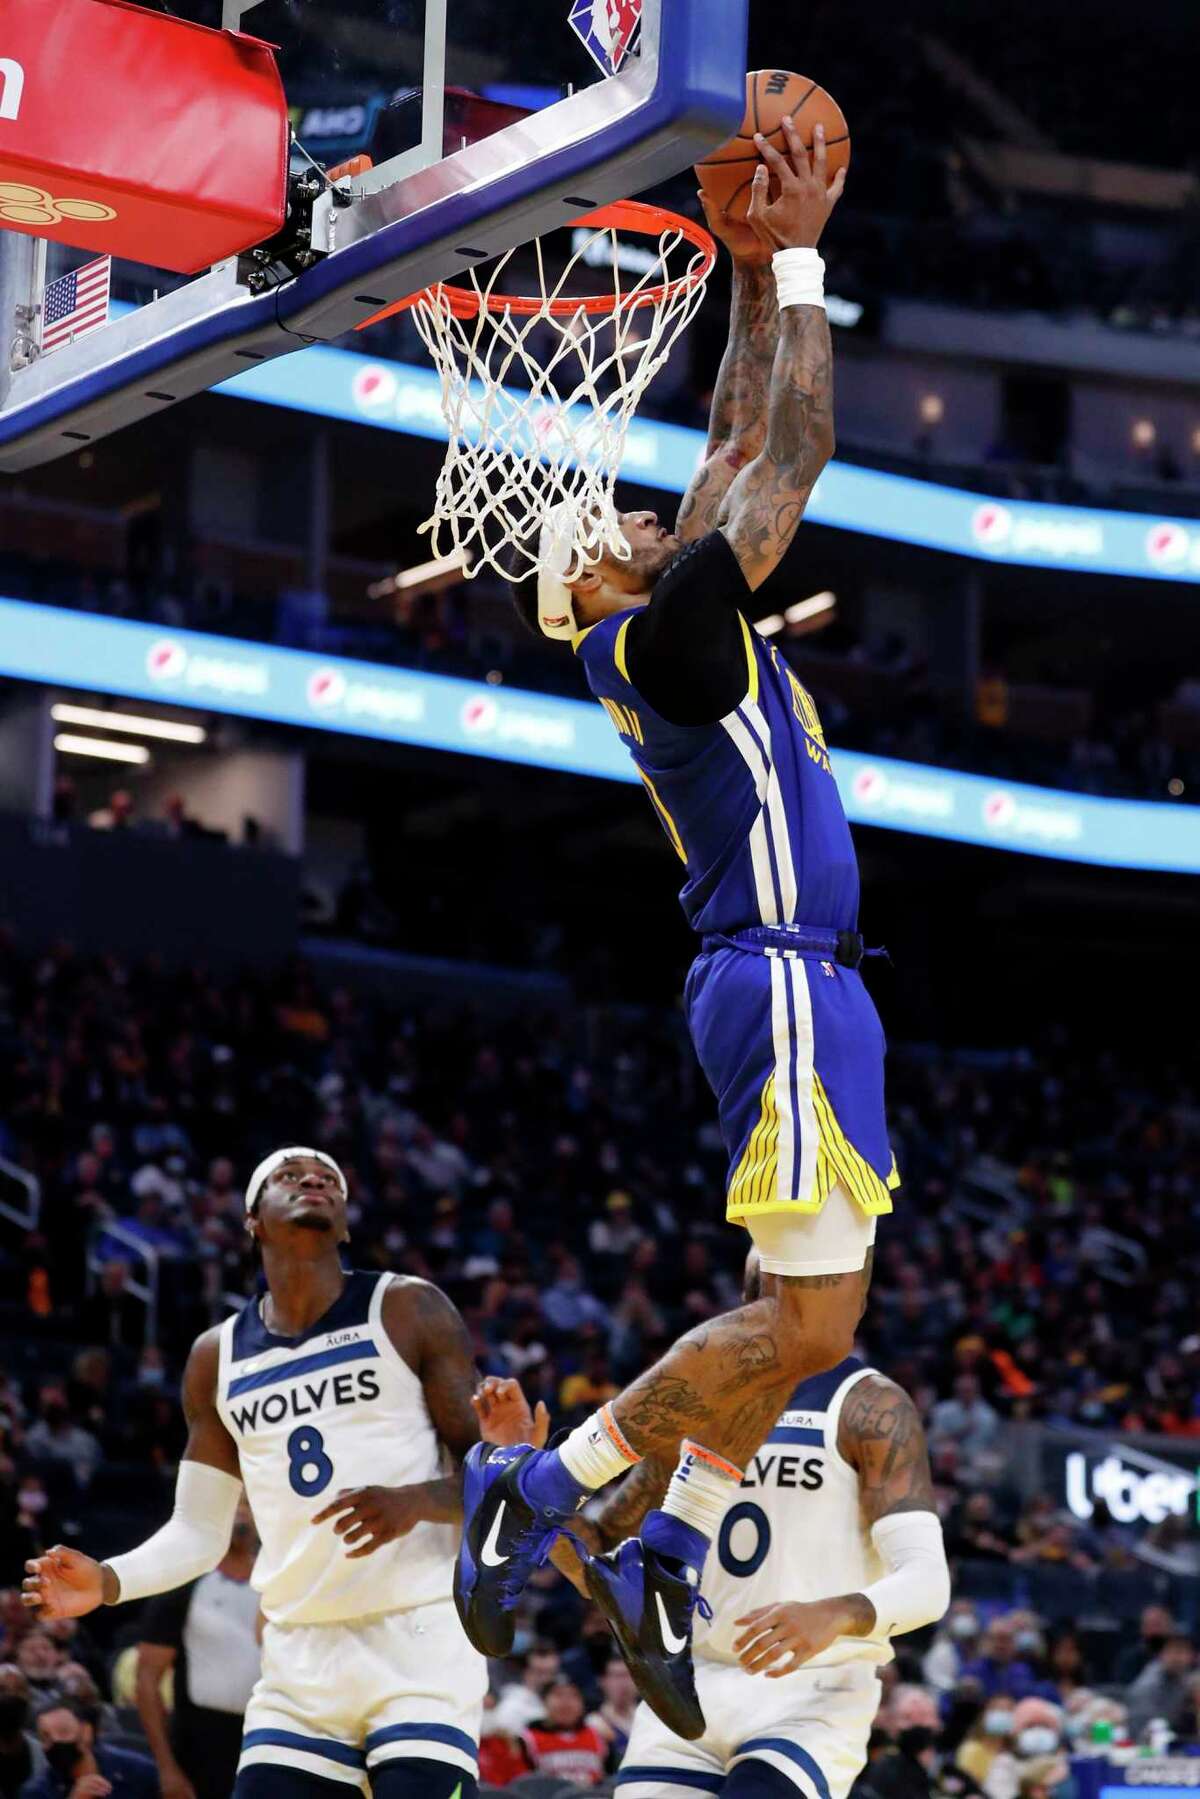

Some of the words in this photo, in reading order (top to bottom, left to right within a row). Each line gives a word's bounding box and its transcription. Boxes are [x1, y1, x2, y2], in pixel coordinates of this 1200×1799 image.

[230, 1369, 380, 1435] WOLVES
[288, 1425, 334, 1498] 8
[718, 1501, 772, 1578] 0
